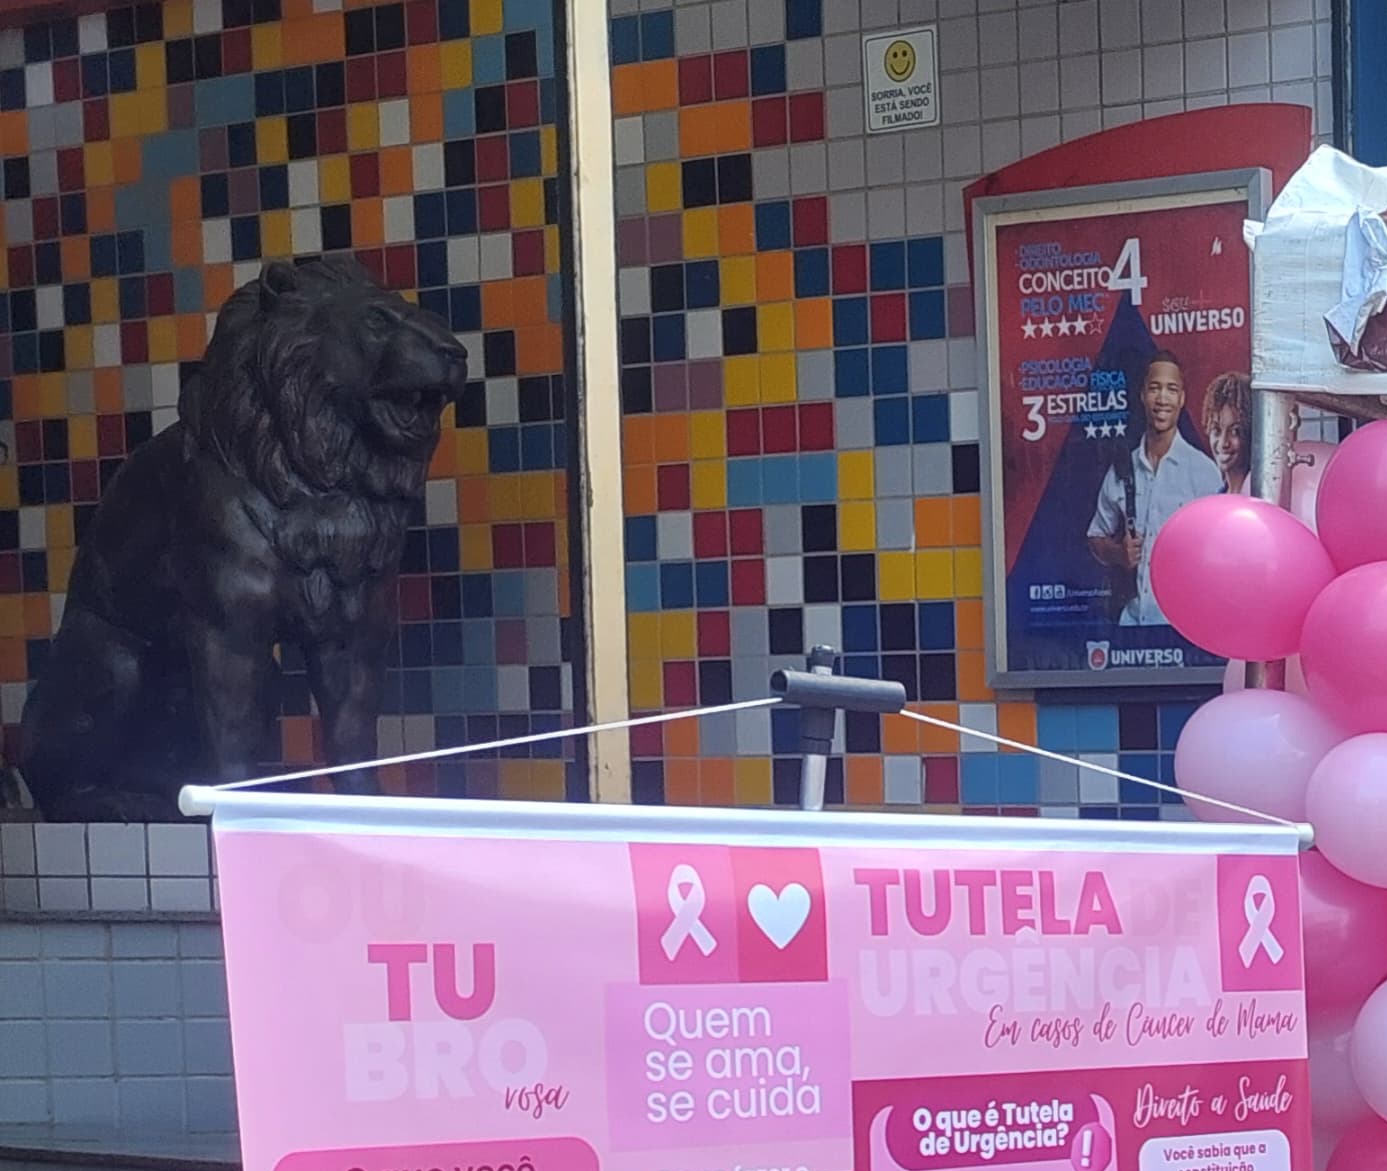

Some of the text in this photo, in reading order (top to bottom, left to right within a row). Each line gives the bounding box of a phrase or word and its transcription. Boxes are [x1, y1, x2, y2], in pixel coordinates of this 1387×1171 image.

[872, 82, 932, 102] SORRIA, VOCÊ
[900, 97, 929, 110] SENDO
[882, 111, 922, 125] FILMADO!
[1019, 238, 1147, 305] CONCEITO 4
[1021, 298, 1063, 317] PELO
[1151, 307, 1244, 335] UNIVERSO
[1022, 390, 1128, 441] 3 ESTRELAS
[1111, 649, 1183, 665] UNIVERSO
[852, 868, 1123, 937] TUTELA
[368, 943, 495, 1021] TU
[857, 927, 1209, 1018] URGÊNCIA
[644, 1002, 771, 1046] Quem
[1031, 1015, 1084, 1048] casos
[1093, 1002, 1117, 1043] de
[1206, 999, 1229, 1035] de
[1237, 999, 1297, 1039] Mama
[344, 1018, 548, 1102] BRO
[646, 1046, 810, 1081] se ama,
[647, 1078, 821, 1123] se cuida
[912, 1099, 1074, 1137] O que é Tutela
[1133, 1083, 1203, 1128] Direito
[1211, 1092, 1227, 1115] a
[919, 1122, 1069, 1160] de Urgência?
